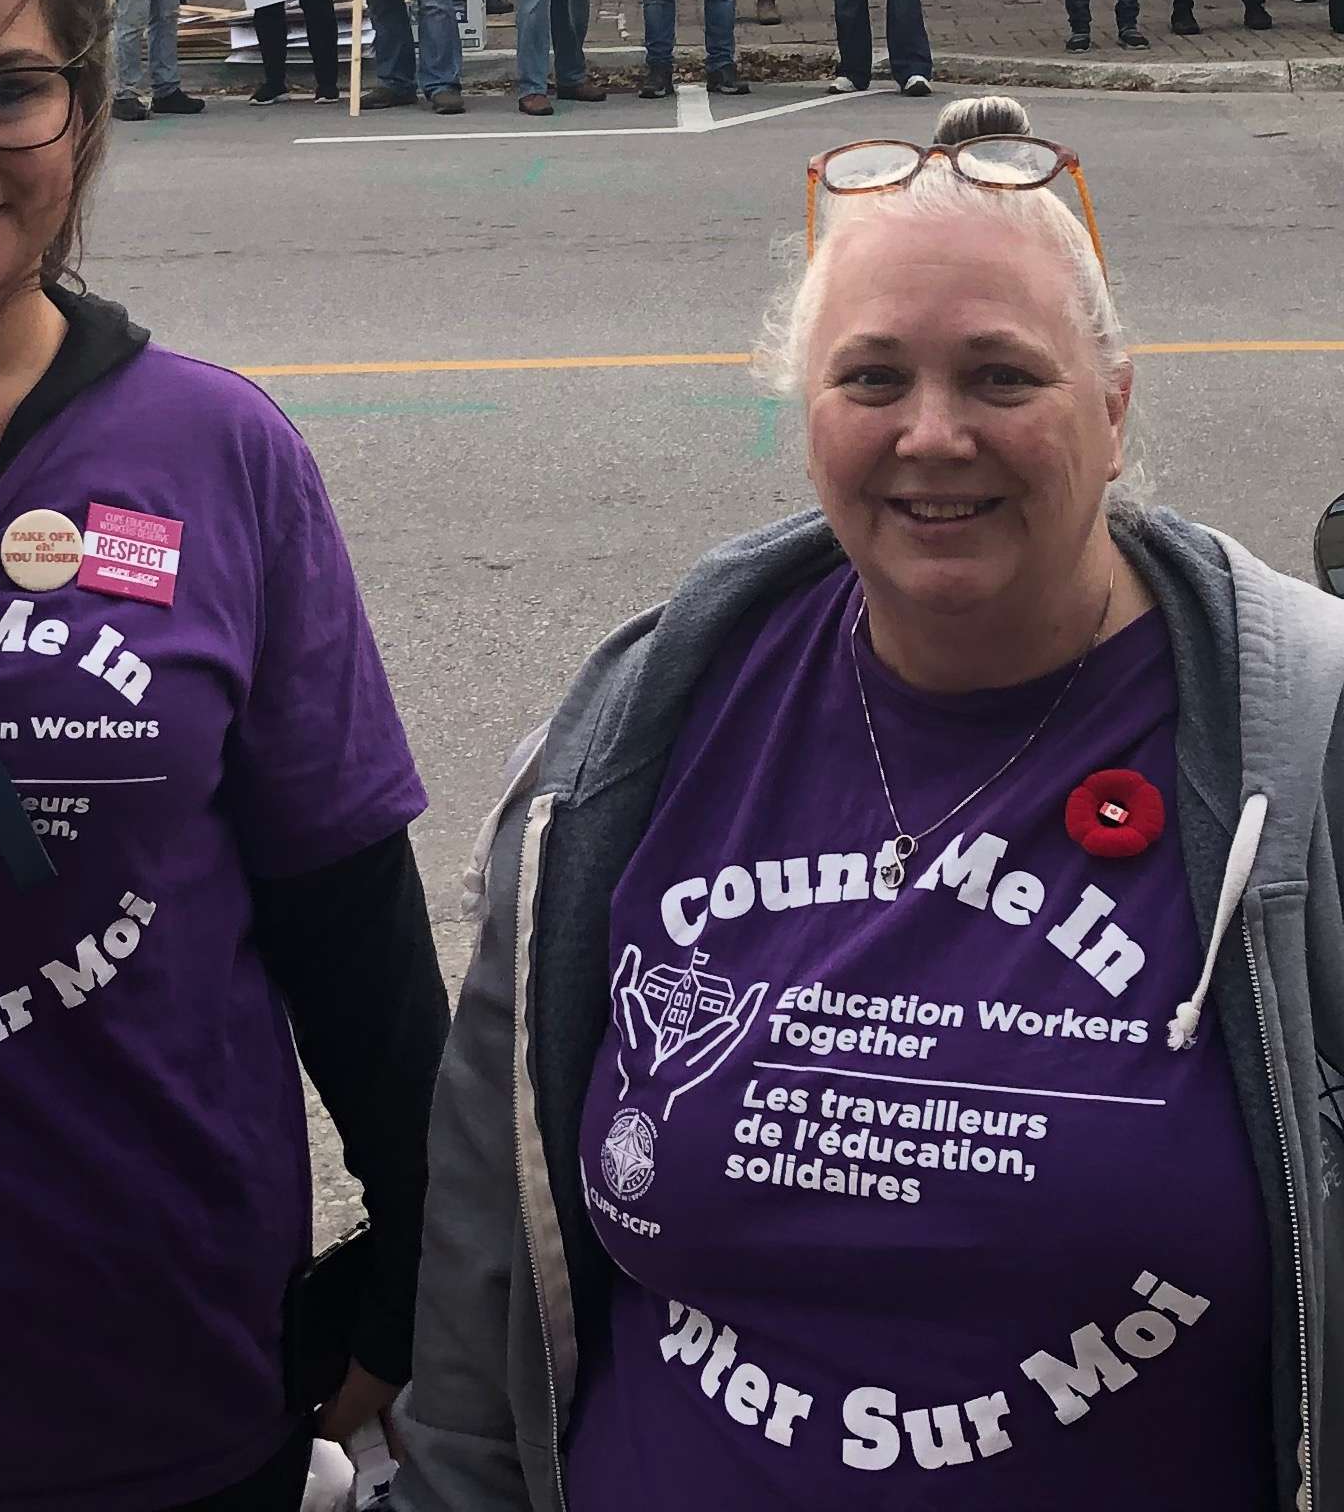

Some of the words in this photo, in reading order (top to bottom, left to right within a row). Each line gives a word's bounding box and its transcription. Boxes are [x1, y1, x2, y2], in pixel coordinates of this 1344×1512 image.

[10, 532, 44, 541] TAKE
[49, 532, 76, 543] OFF,
[100, 520, 136, 536] WORKERS
[106, 512, 123, 523] CUPE
[124, 516, 166, 533] EDUCATION
[5, 553, 32, 562] YOU
[35, 553, 79, 563] HOSER
[96, 536, 167, 568] RESPECT
[77, 624, 154, 707] In
[30, 716, 160, 740] Workers
[659, 840, 910, 947] Count
[921, 830, 1047, 929] Me
[1043, 884, 1149, 998] In
[41, 891, 158, 1010] Moi
[767, 1017, 938, 1061] Together
[776, 982, 965, 1029] Education
[978, 1000, 1149, 1047] Workers
[741, 1080, 806, 1114] Les
[820, 1086, 1049, 1140] travailleurs
[724, 1149, 922, 1206] solidaires
[734, 1115, 789, 1149] de
[795, 1117, 1038, 1184] l'éducation,
[841, 1385, 1014, 1471] Sur
[1019, 1269, 1212, 1428] Moi
